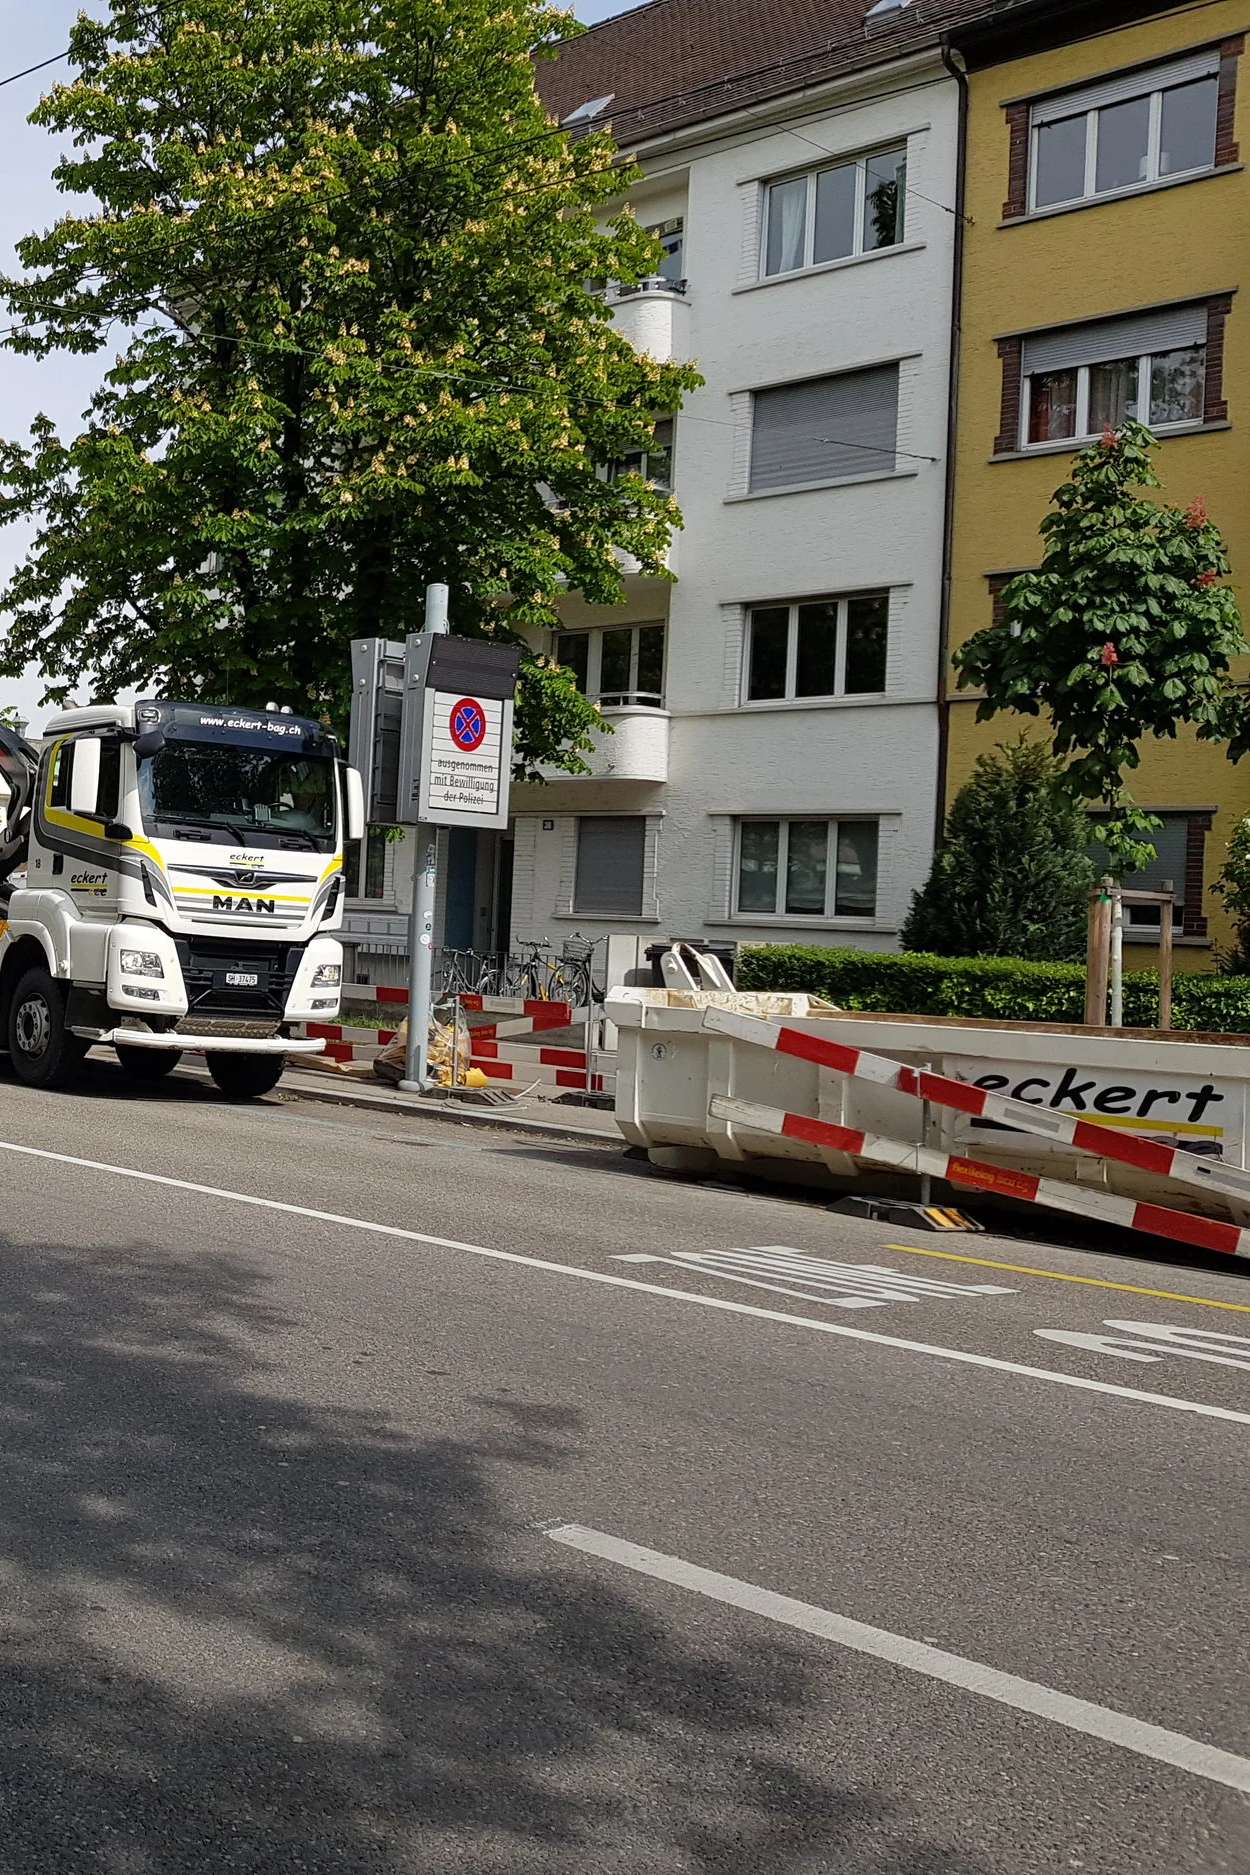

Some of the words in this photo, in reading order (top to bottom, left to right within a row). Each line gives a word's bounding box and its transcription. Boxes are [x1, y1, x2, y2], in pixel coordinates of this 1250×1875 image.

[200, 717, 301, 735] www.eckert-bag.ch
[437, 759, 493, 773] ausgenommen
[434, 773, 447, 786] mit
[450, 775, 494, 793] Bewilligung
[444, 790, 457, 802] der
[459, 792, 484, 805] Polizei
[230, 853, 265, 862] eckert
[70, 871, 107, 884] eckert
[212, 895, 275, 913] MAN
[972, 1067, 1224, 1122] eckert
